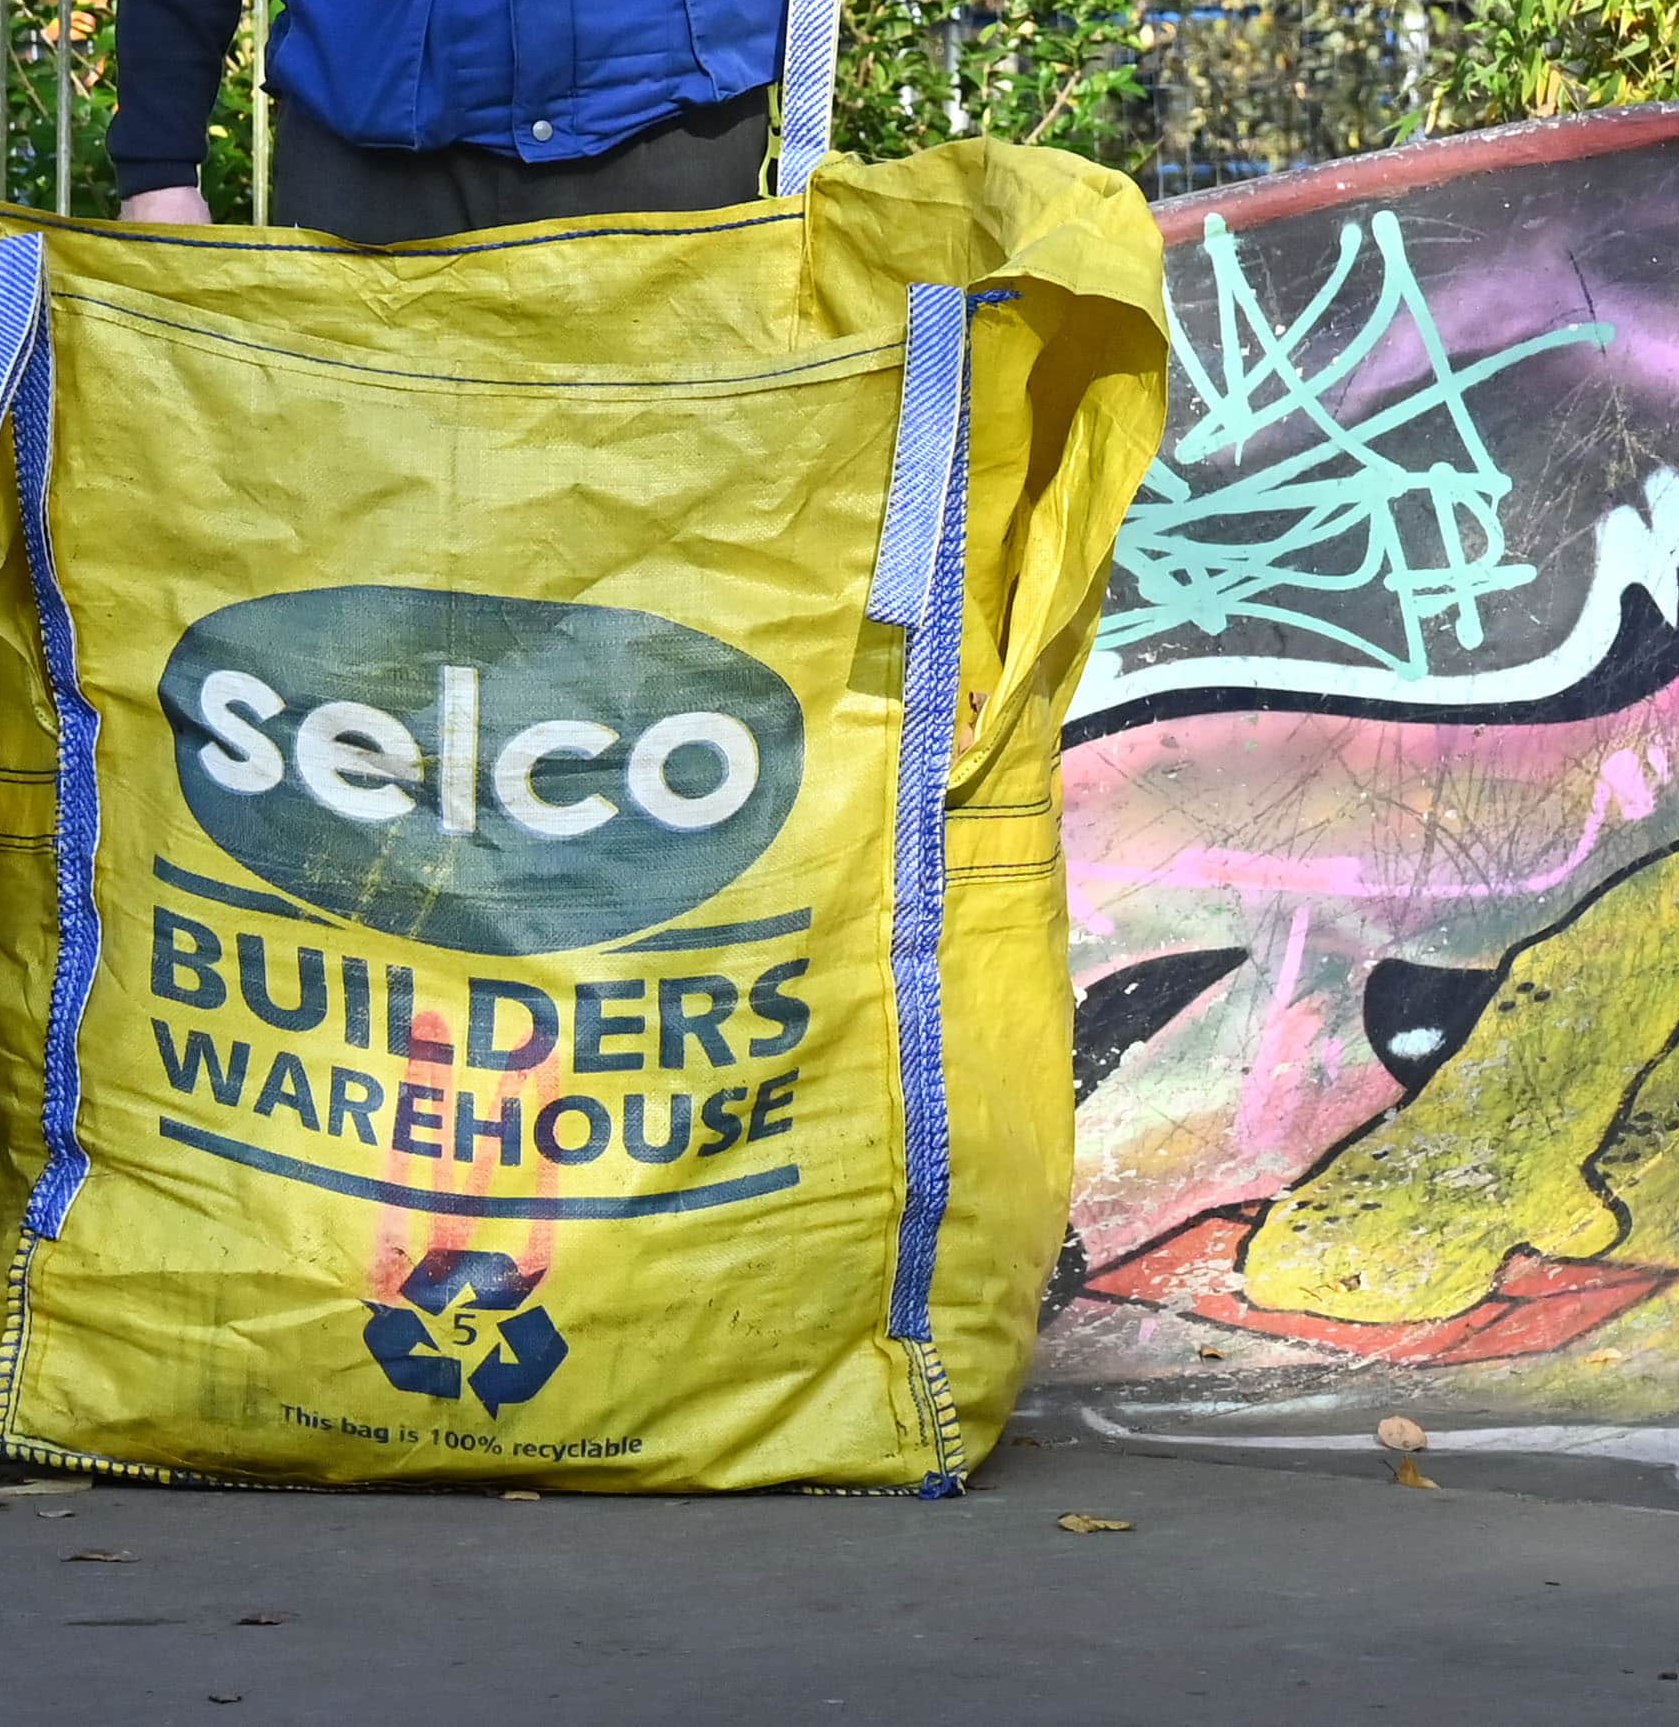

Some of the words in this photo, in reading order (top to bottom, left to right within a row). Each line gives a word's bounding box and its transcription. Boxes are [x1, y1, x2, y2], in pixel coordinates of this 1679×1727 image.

[198, 664, 761, 839] selco
[150, 904, 811, 1074] BUILDERS
[150, 1016, 800, 1167] WAREHOUSE
[452, 1312, 478, 1346] 5
[280, 1403, 332, 1431] This
[340, 1417, 390, 1444] bag
[399, 1424, 420, 1444] is
[431, 1428, 503, 1456] 100%
[512, 1435, 644, 1462] recyclable
